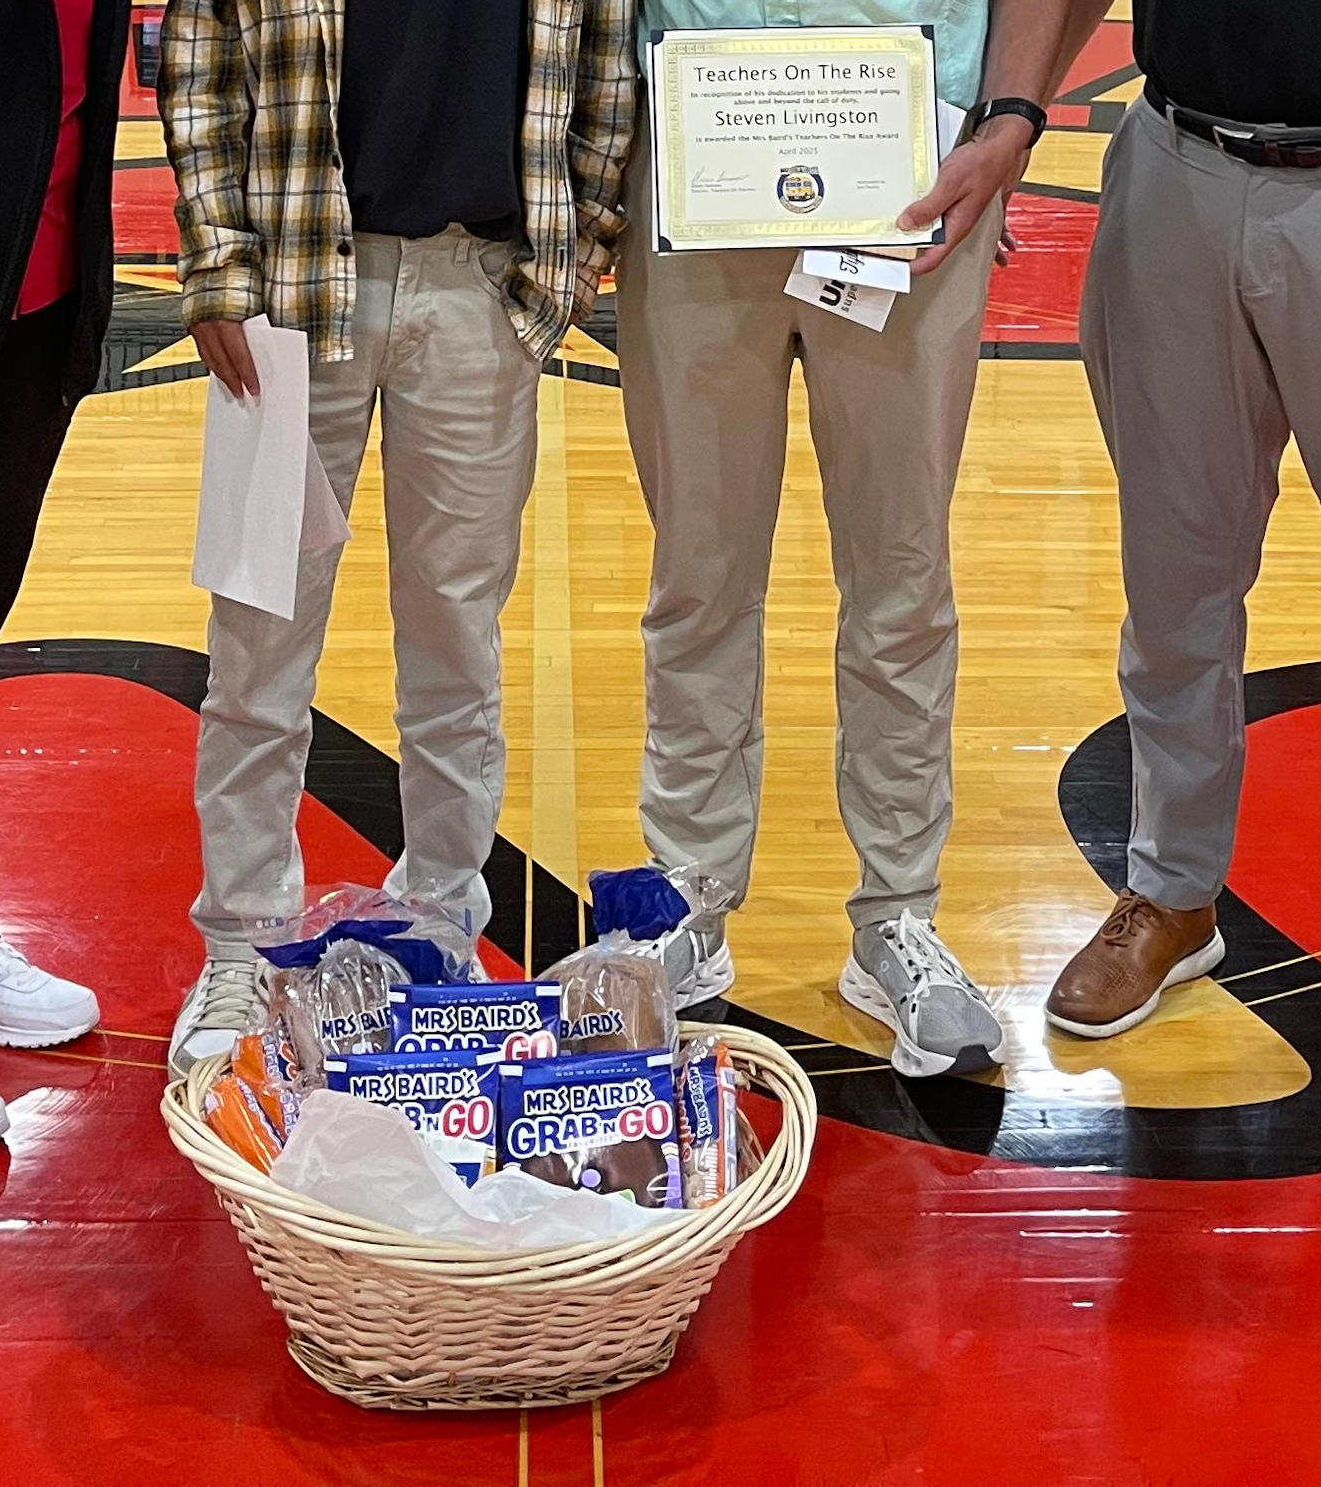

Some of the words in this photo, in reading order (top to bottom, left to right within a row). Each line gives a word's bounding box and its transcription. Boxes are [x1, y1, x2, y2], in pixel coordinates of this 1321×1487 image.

[694, 66, 777, 83] Teachers
[785, 65, 810, 80] On
[818, 64, 852, 80] The
[860, 64, 896, 79] Rise
[715, 110, 775, 126] Steven
[784, 109, 878, 128] Livingston
[322, 1014, 357, 1039] MRS
[414, 1007, 455, 1030] MRS
[460, 1004, 539, 1030] BAIRD'S
[559, 1010, 624, 1039] BAIRD'S
[505, 1035, 554, 1061] GO
[352, 1075, 393, 1098] MRS
[397, 1070, 477, 1097] BAIRD'S
[689, 1067, 703, 1093] MRS
[527, 1087, 567, 1113] MRS
[573, 1081, 650, 1109] BAIRD'S
[442, 1099, 490, 1138] GO
[510, 1116, 598, 1155] GRAB
[619, 1104, 669, 1138] GO
